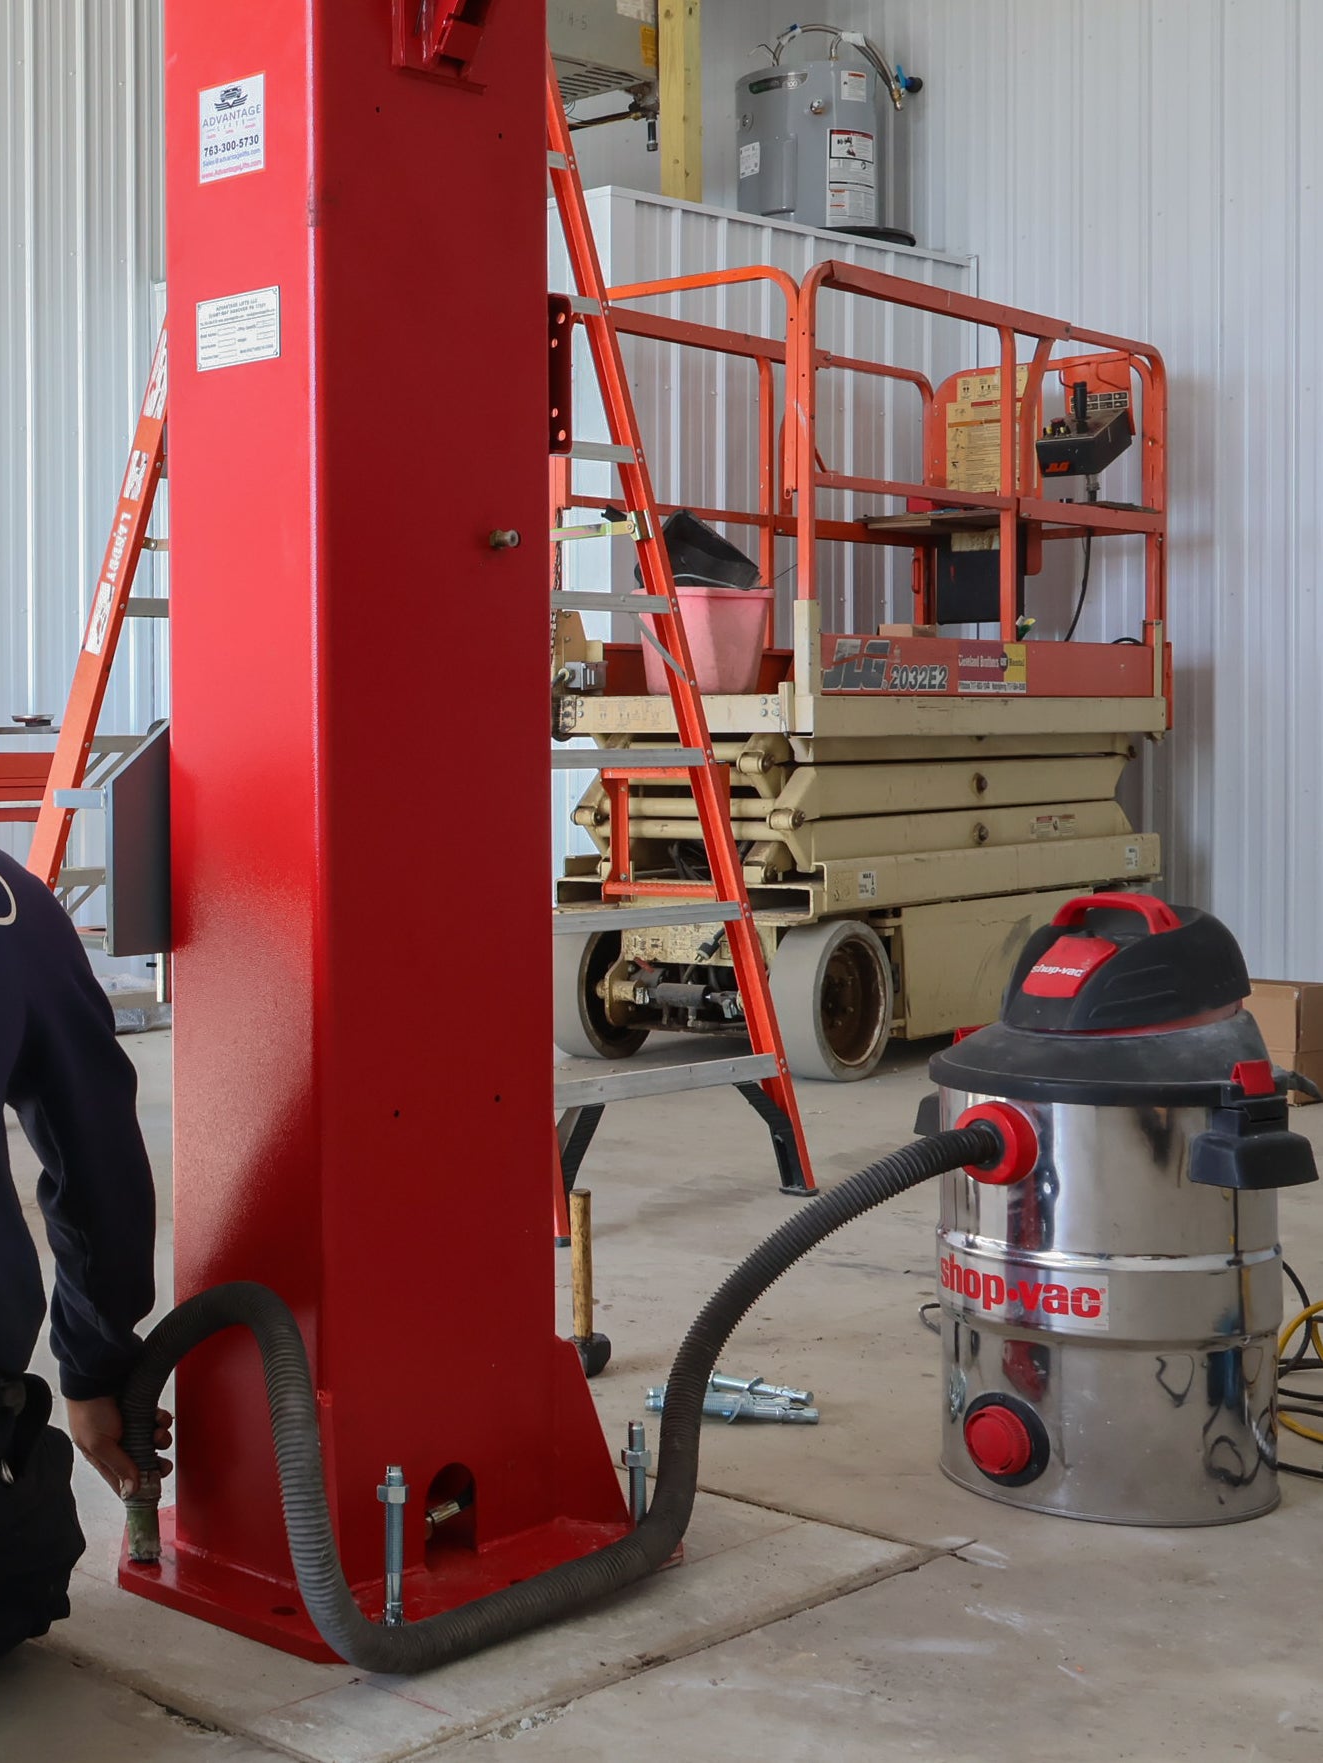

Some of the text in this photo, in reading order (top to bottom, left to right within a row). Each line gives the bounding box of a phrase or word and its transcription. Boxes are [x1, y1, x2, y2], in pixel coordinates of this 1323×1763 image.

[202, 104, 262, 128] ADVANTAGE
[204, 134, 259, 157] 763-300-5730
[889, 664, 949, 691] 2032E2
